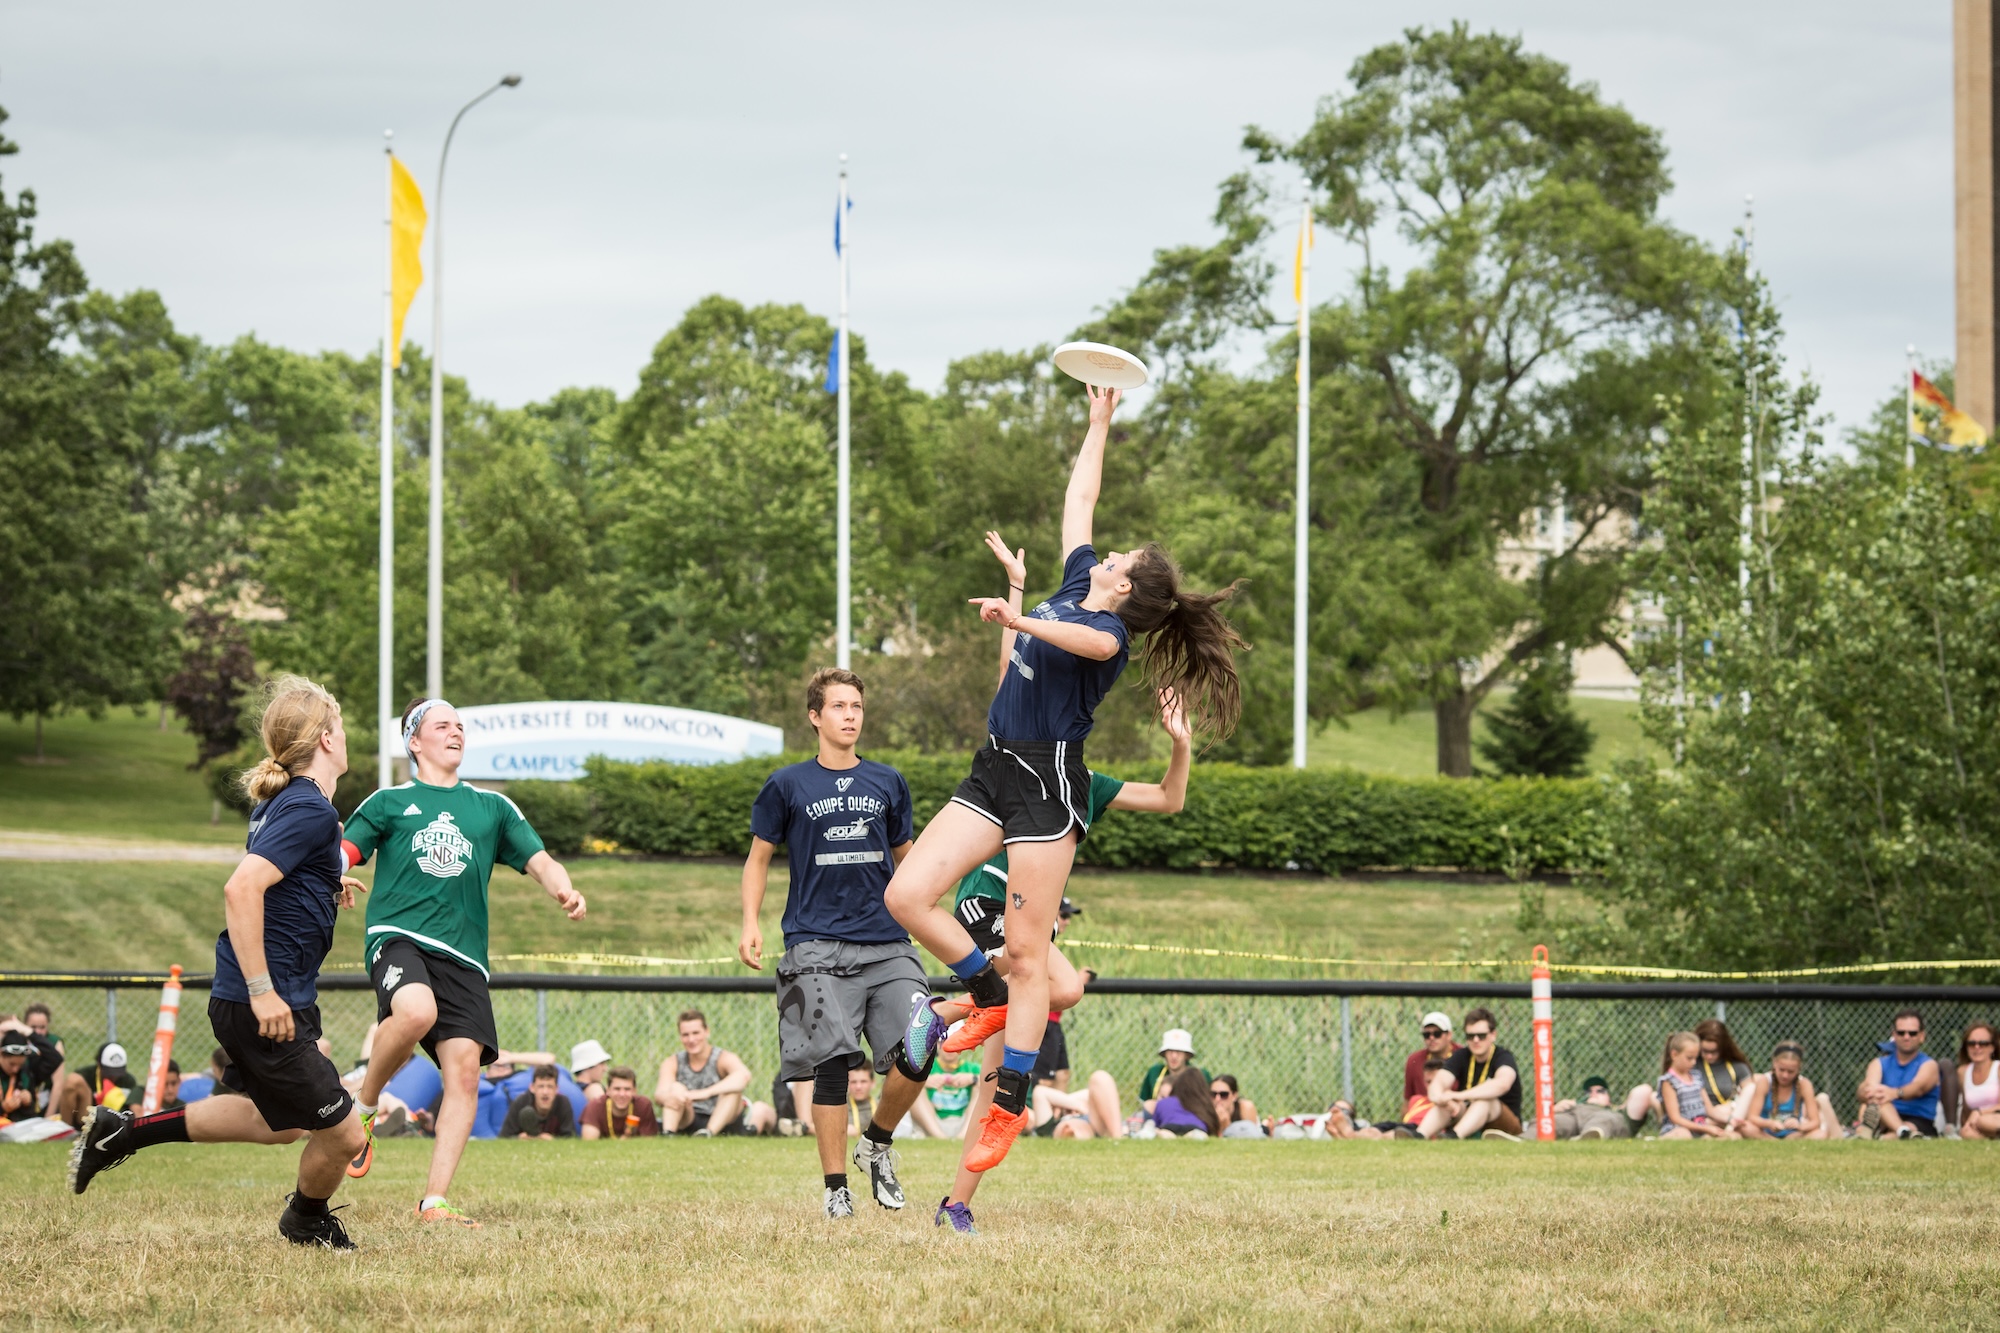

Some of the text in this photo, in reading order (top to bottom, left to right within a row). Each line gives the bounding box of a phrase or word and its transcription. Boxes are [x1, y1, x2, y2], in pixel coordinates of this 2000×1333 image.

[585, 711, 608, 728] DE
[623, 713, 724, 739] MONCTON
[491, 753, 579, 774] CAMPUS
[806, 796, 844, 820] ÉQUIPE
[414, 831, 470, 854] ÉQUIPE
[432, 845, 454, 866] NB
[837, 853, 865, 862] ULTIMATE
[1537, 1027, 1552, 1135] EVENTS
